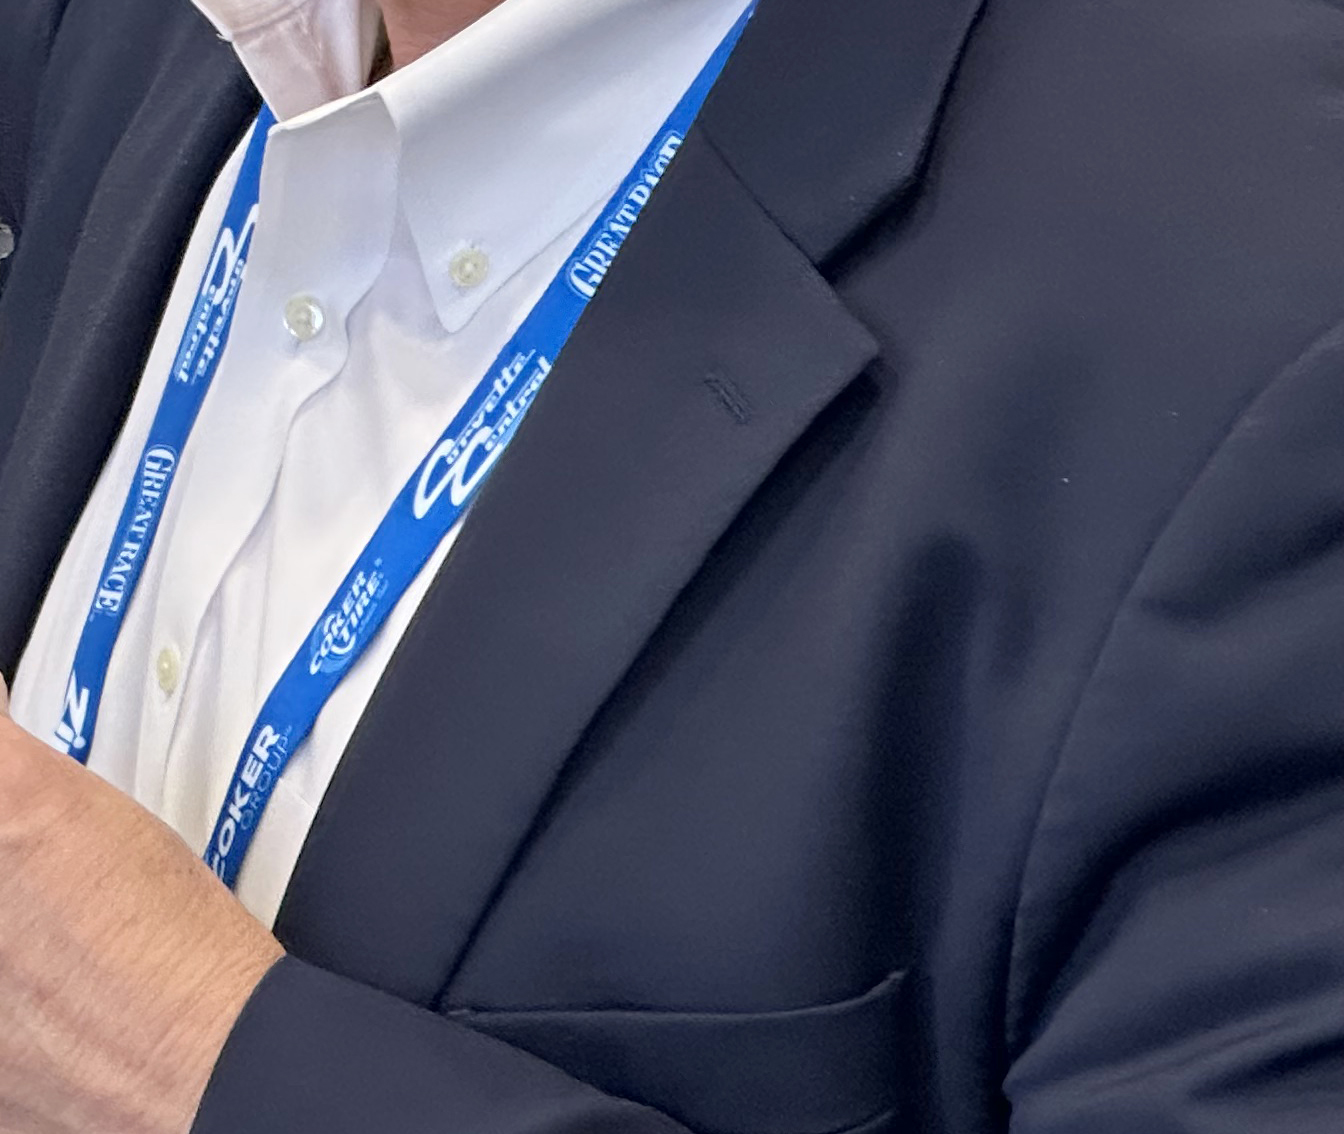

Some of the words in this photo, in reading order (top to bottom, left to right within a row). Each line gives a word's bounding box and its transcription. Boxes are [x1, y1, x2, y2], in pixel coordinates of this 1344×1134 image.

[178, 227, 235, 382] Central
[191, 203, 259, 385] Corvette
[569, 203, 638, 299] GREAT
[131, 447, 176, 540] GREAT
[413, 349, 536, 519] Corvette
[451, 356, 552, 506] Central
[96, 540, 141, 612] RACE
[310, 571, 366, 675] COKER
[337, 571, 380, 643] TIRE
[212, 724, 281, 881] COKER
